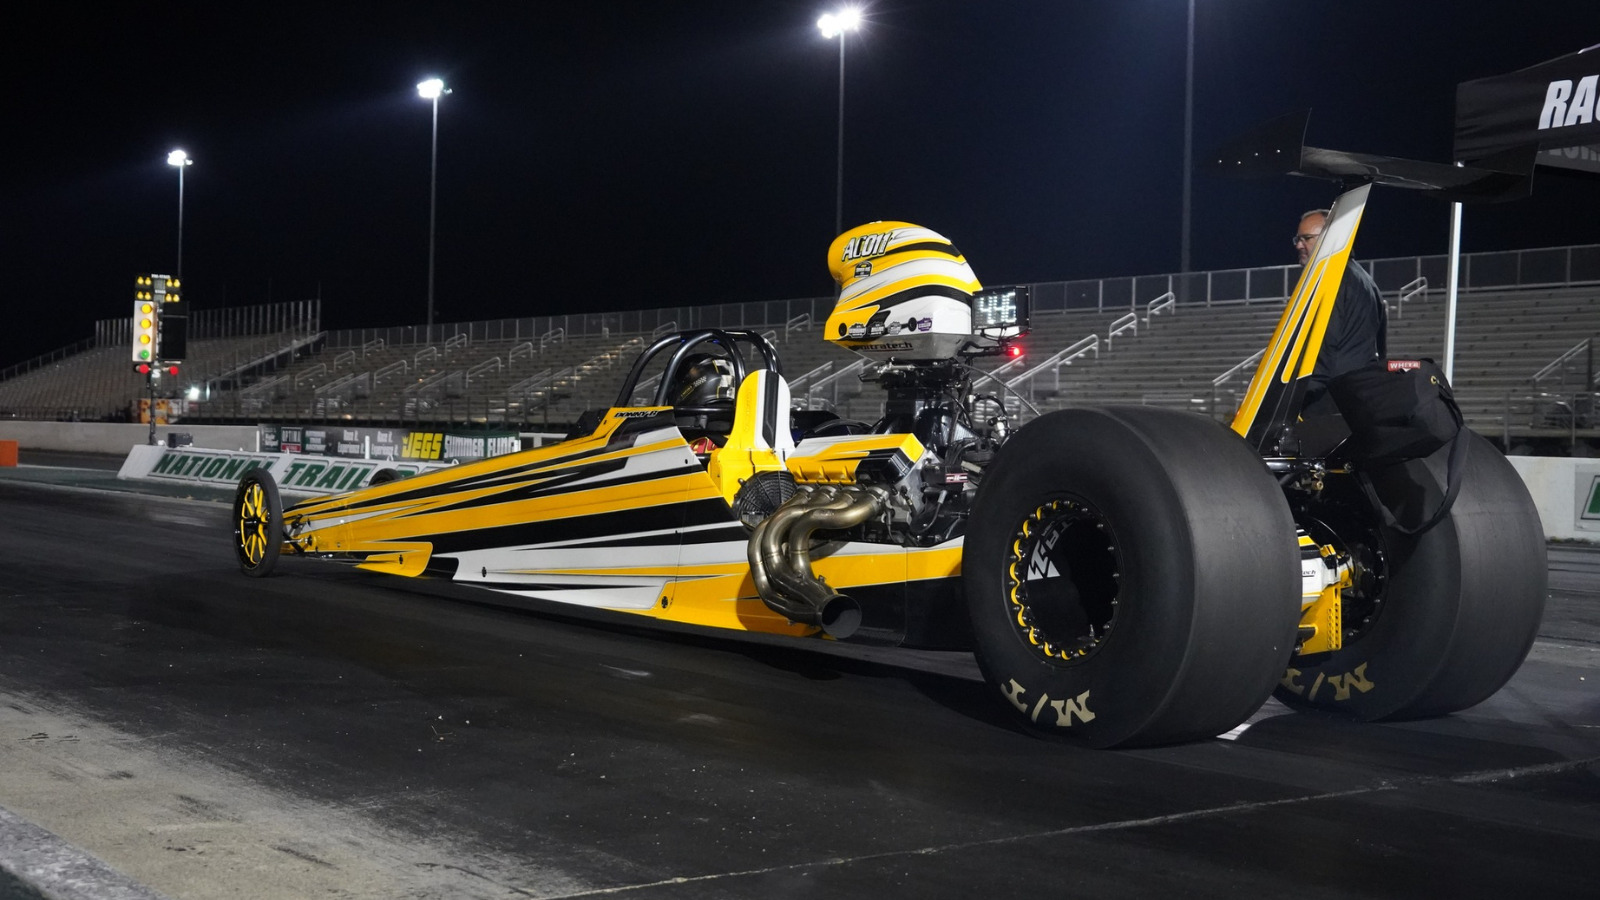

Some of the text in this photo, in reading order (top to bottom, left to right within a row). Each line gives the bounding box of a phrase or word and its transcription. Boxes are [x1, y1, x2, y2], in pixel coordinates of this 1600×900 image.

[1538, 74, 1600, 130] RA
[401, 432, 443, 460] JEGS
[443, 435, 485, 458] SUMMER
[281, 463, 371, 490] TRAIL
